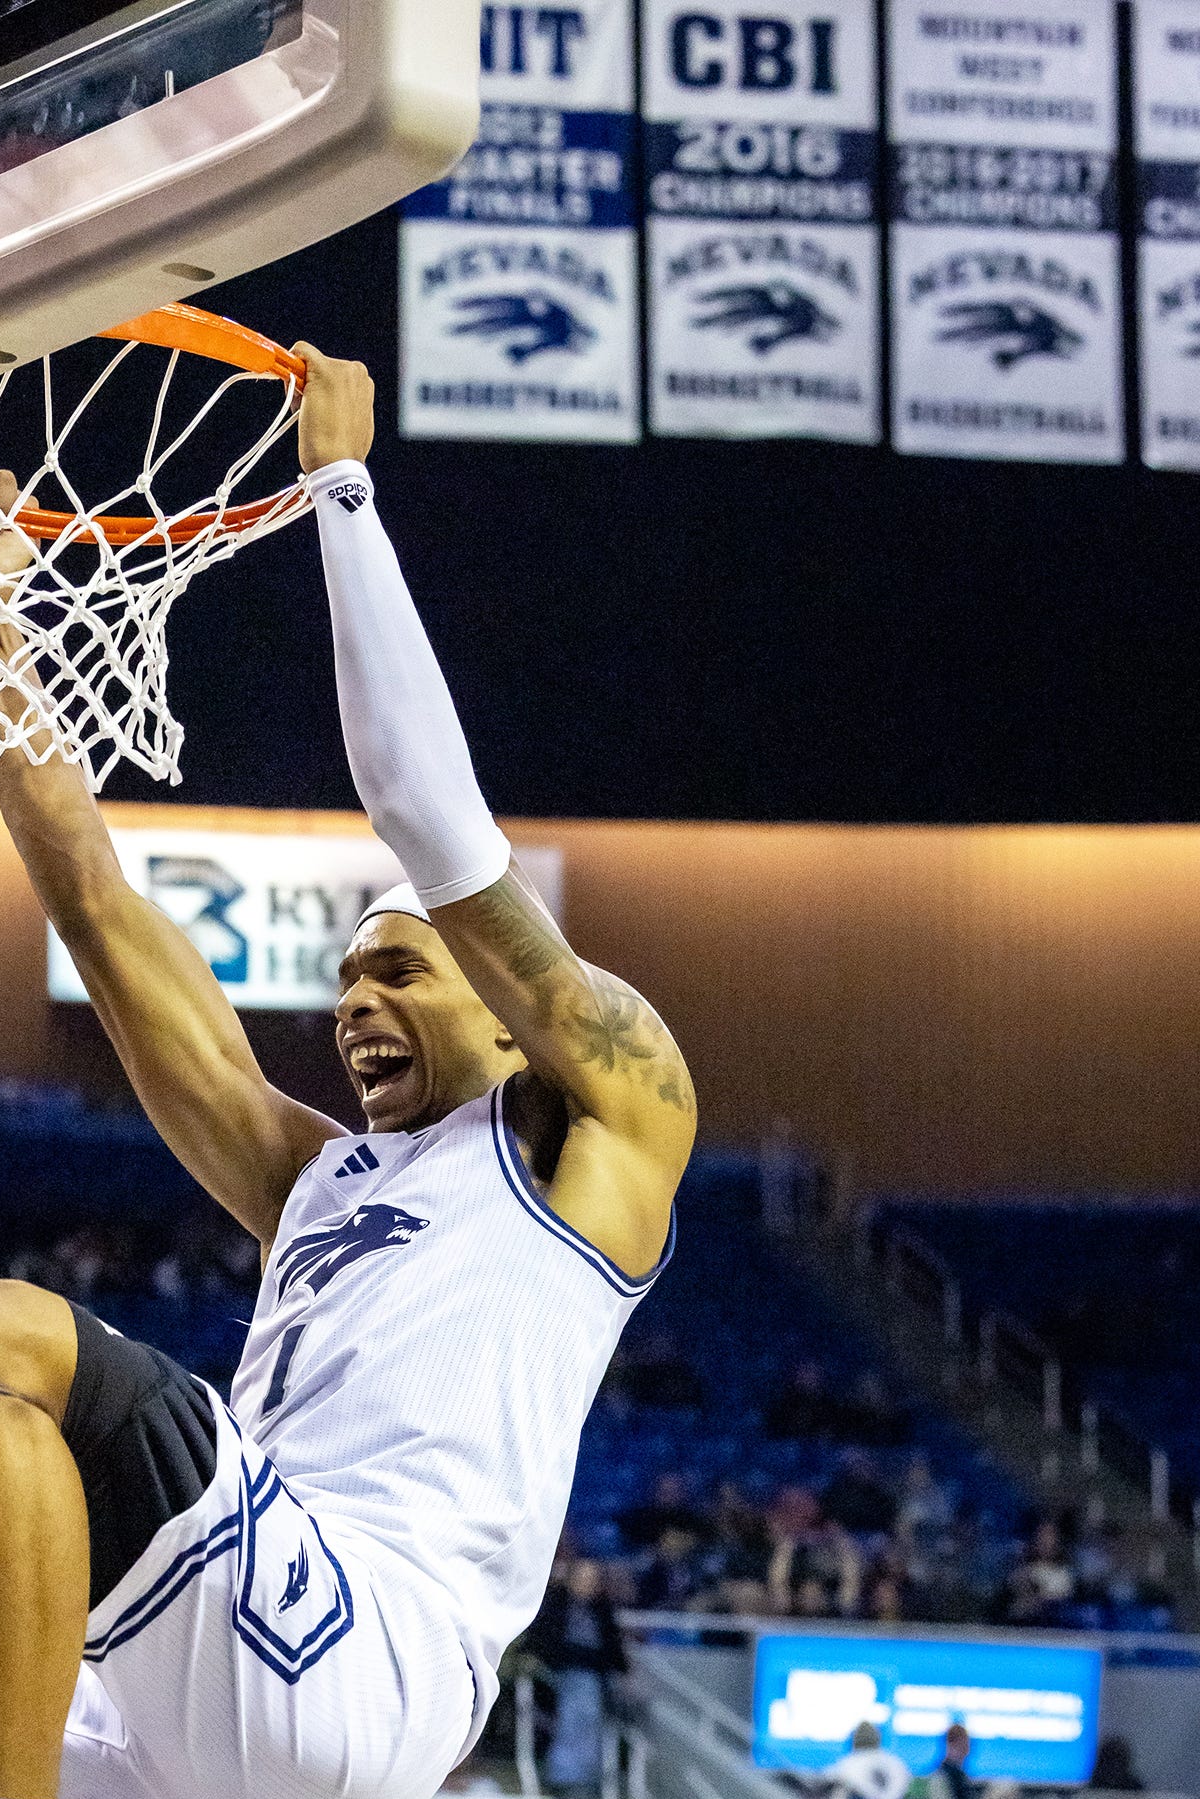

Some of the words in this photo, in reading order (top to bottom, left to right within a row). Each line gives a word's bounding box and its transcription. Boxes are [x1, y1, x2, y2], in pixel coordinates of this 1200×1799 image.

[670, 13, 836, 95] CBI
[674, 122, 841, 176] 2016
[421, 244, 618, 303] NEVADA
[328, 483, 368, 500] adidas
